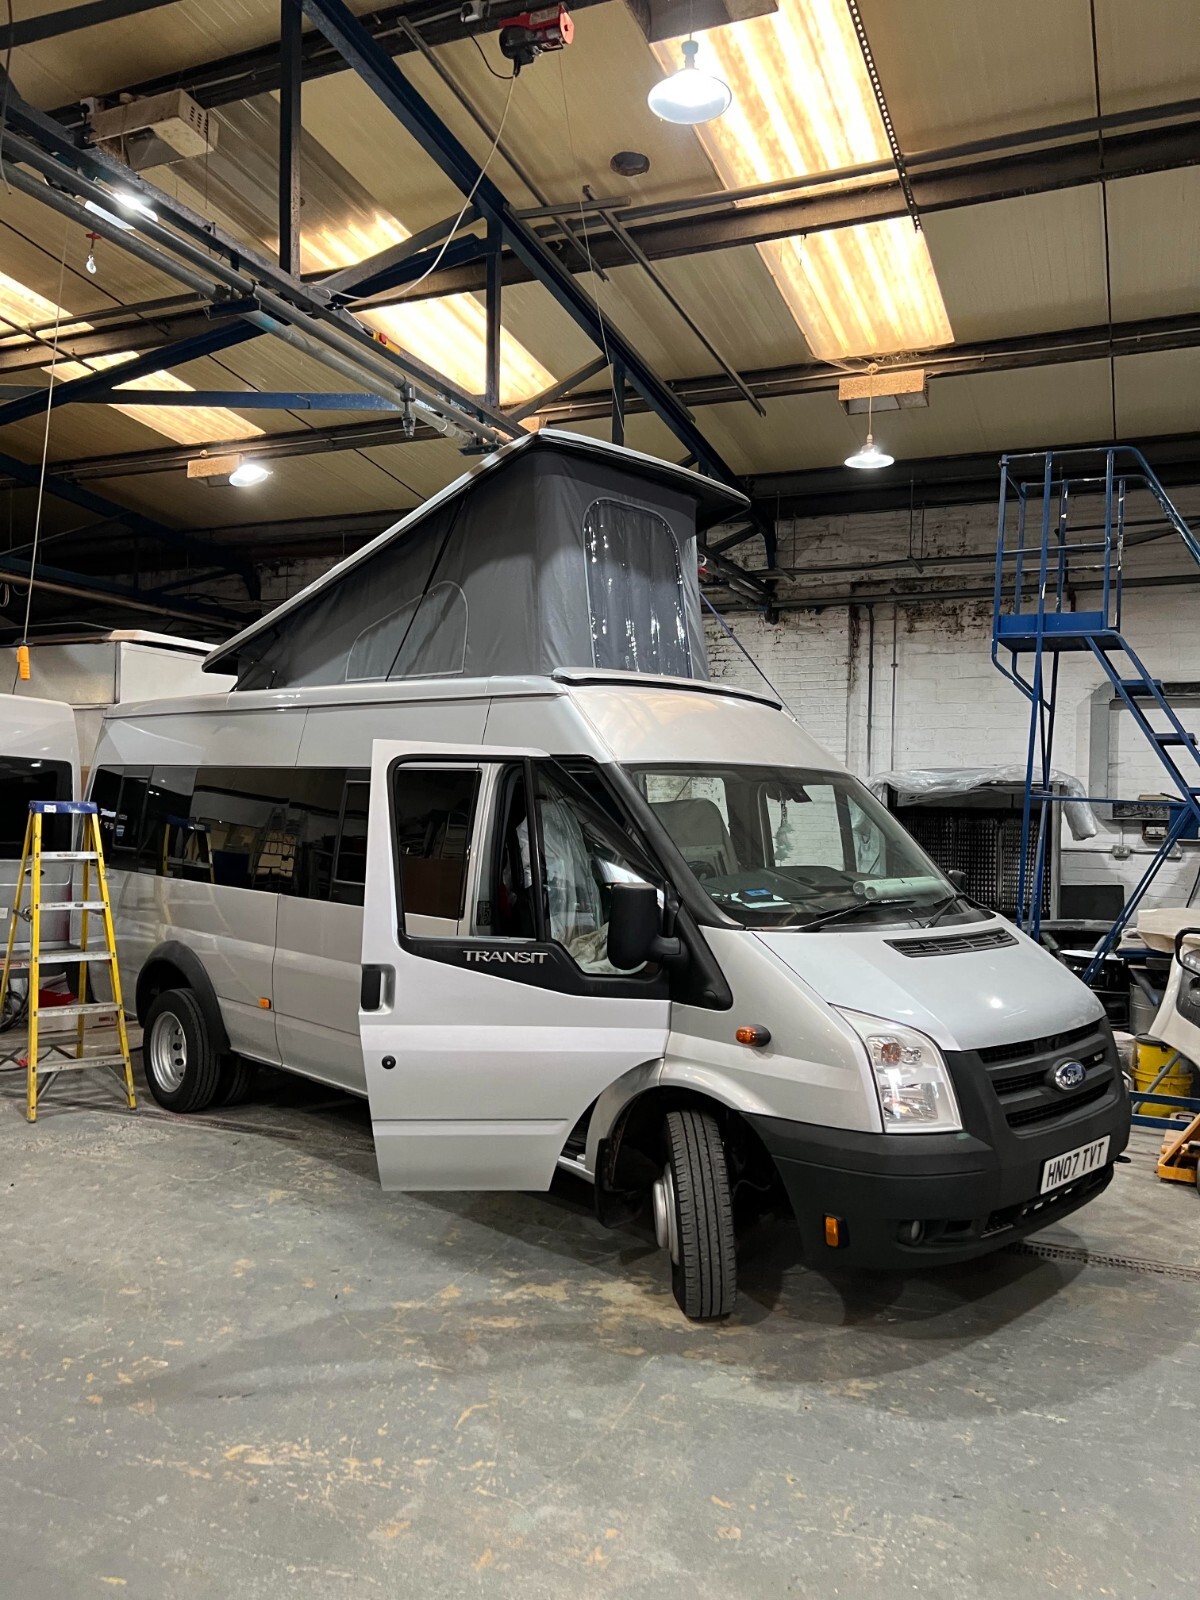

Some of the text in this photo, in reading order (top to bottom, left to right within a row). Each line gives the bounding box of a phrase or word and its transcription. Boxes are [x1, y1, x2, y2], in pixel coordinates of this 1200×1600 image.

[463, 950, 548, 964] TRANSIT
[1046, 1141, 1105, 1188] HN07 TVT
